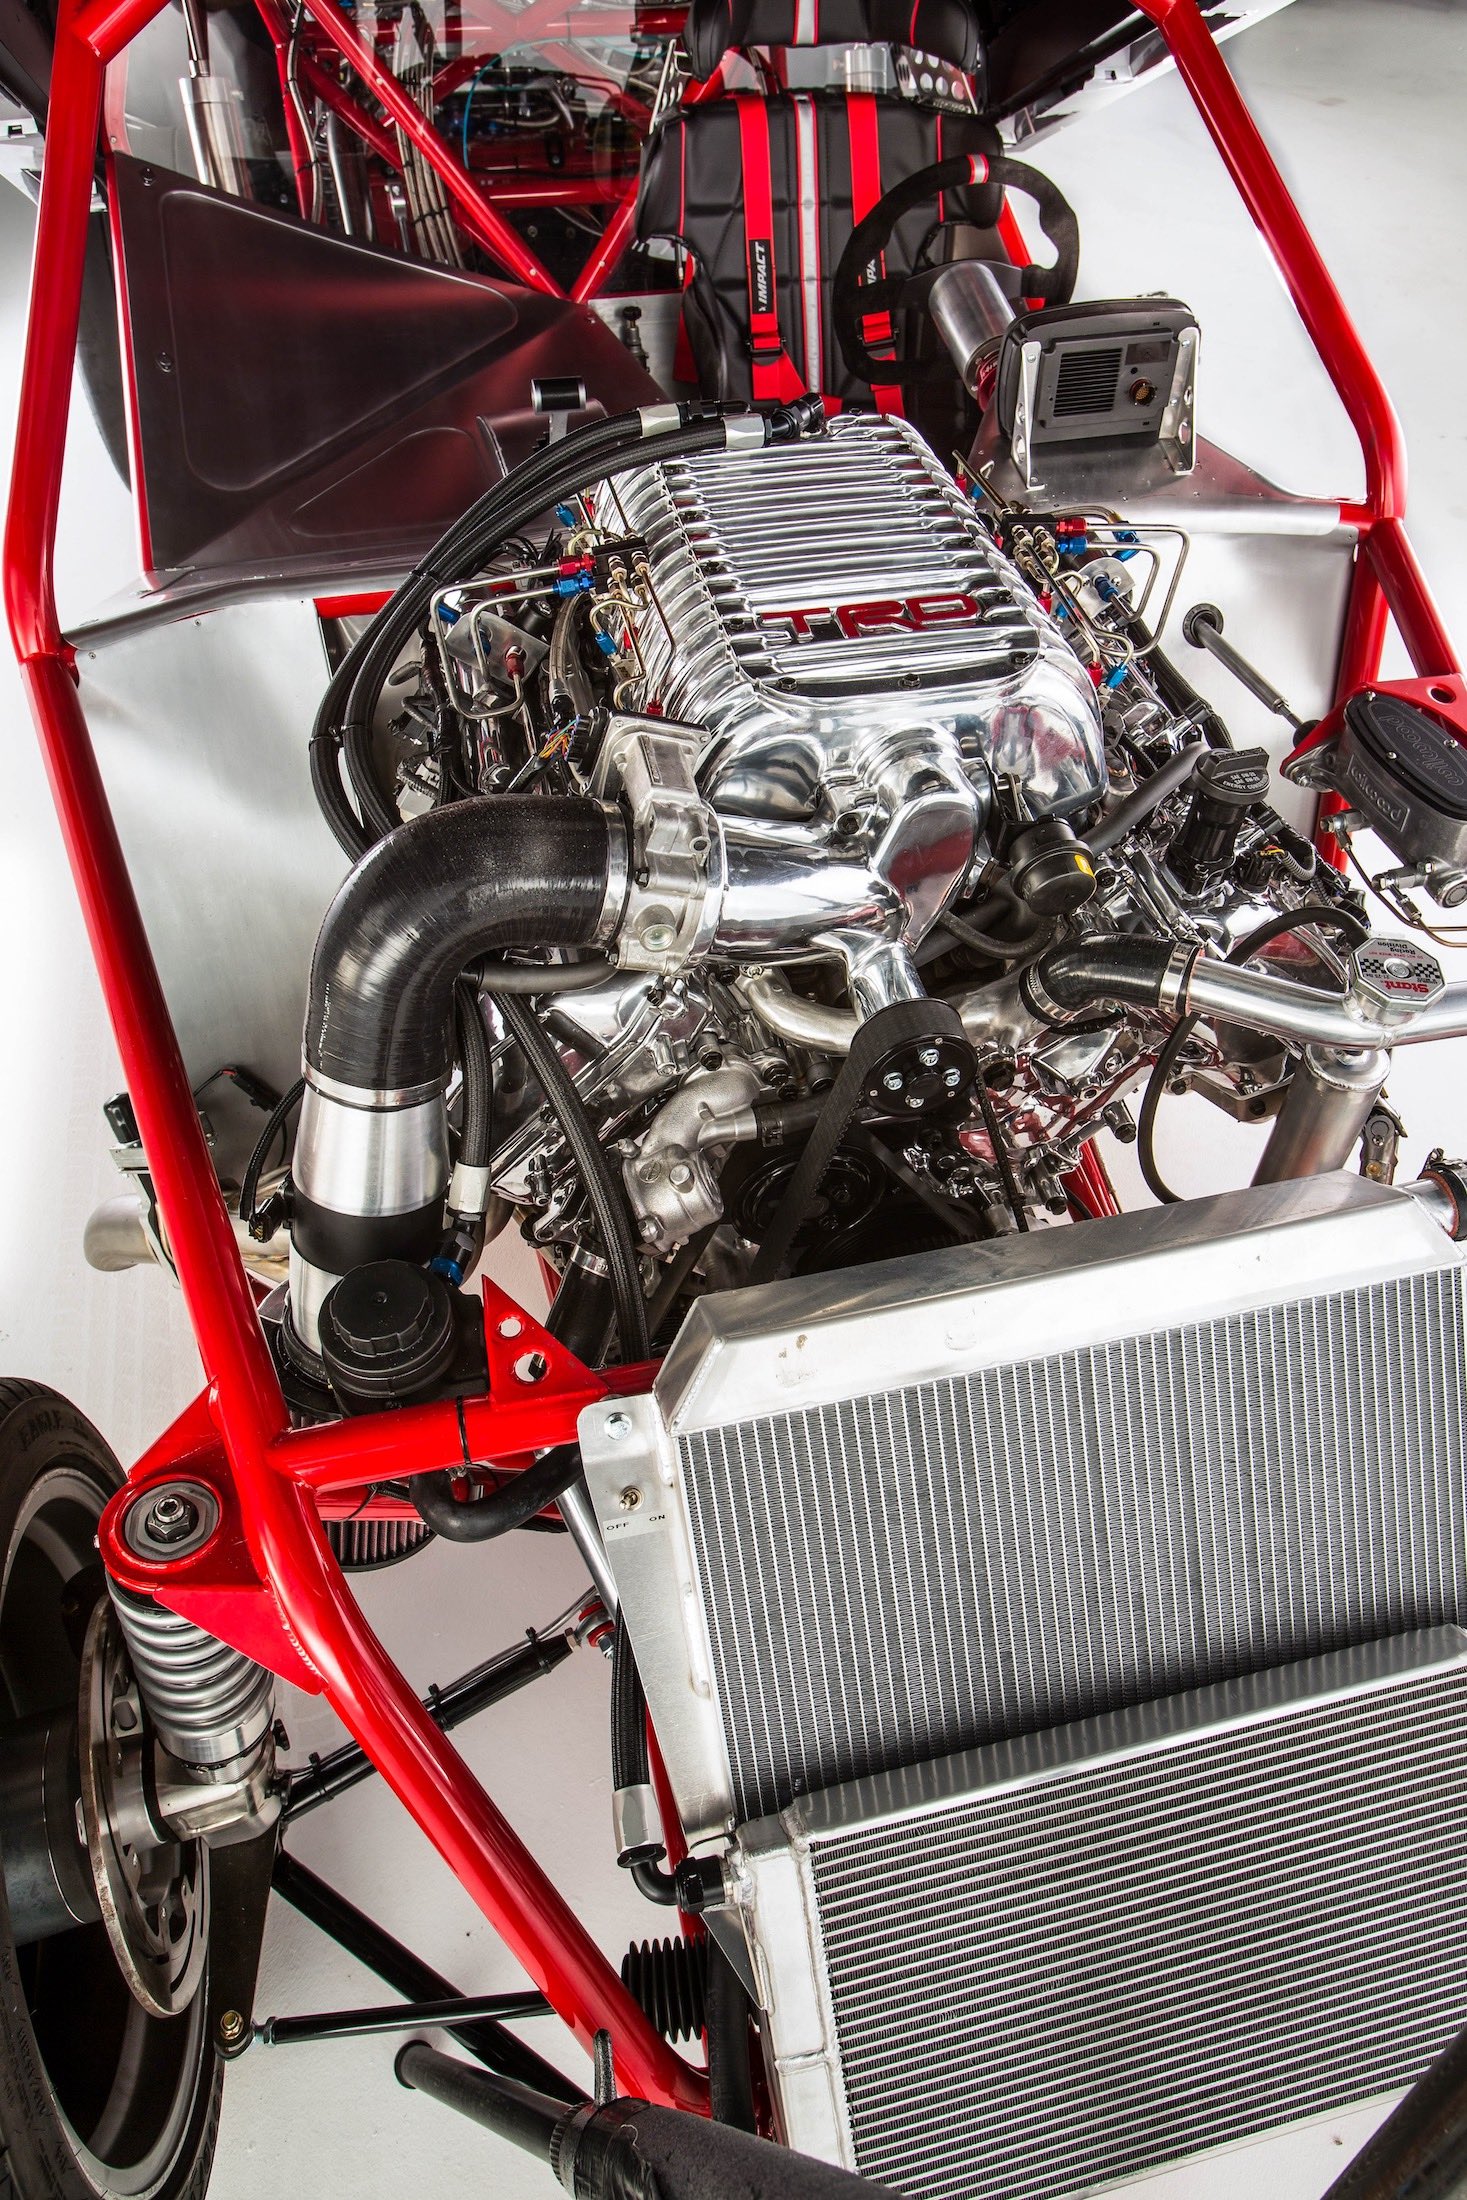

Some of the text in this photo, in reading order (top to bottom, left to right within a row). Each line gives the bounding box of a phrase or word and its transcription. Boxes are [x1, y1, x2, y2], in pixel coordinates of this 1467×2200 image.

[755, 241, 767, 304] IMPACT
[758, 593, 981, 641] TRD
[1390, 947, 1416, 955] Racing
[1384, 980, 1429, 993] Stant
[606, 1522, 629, 1530] OFF
